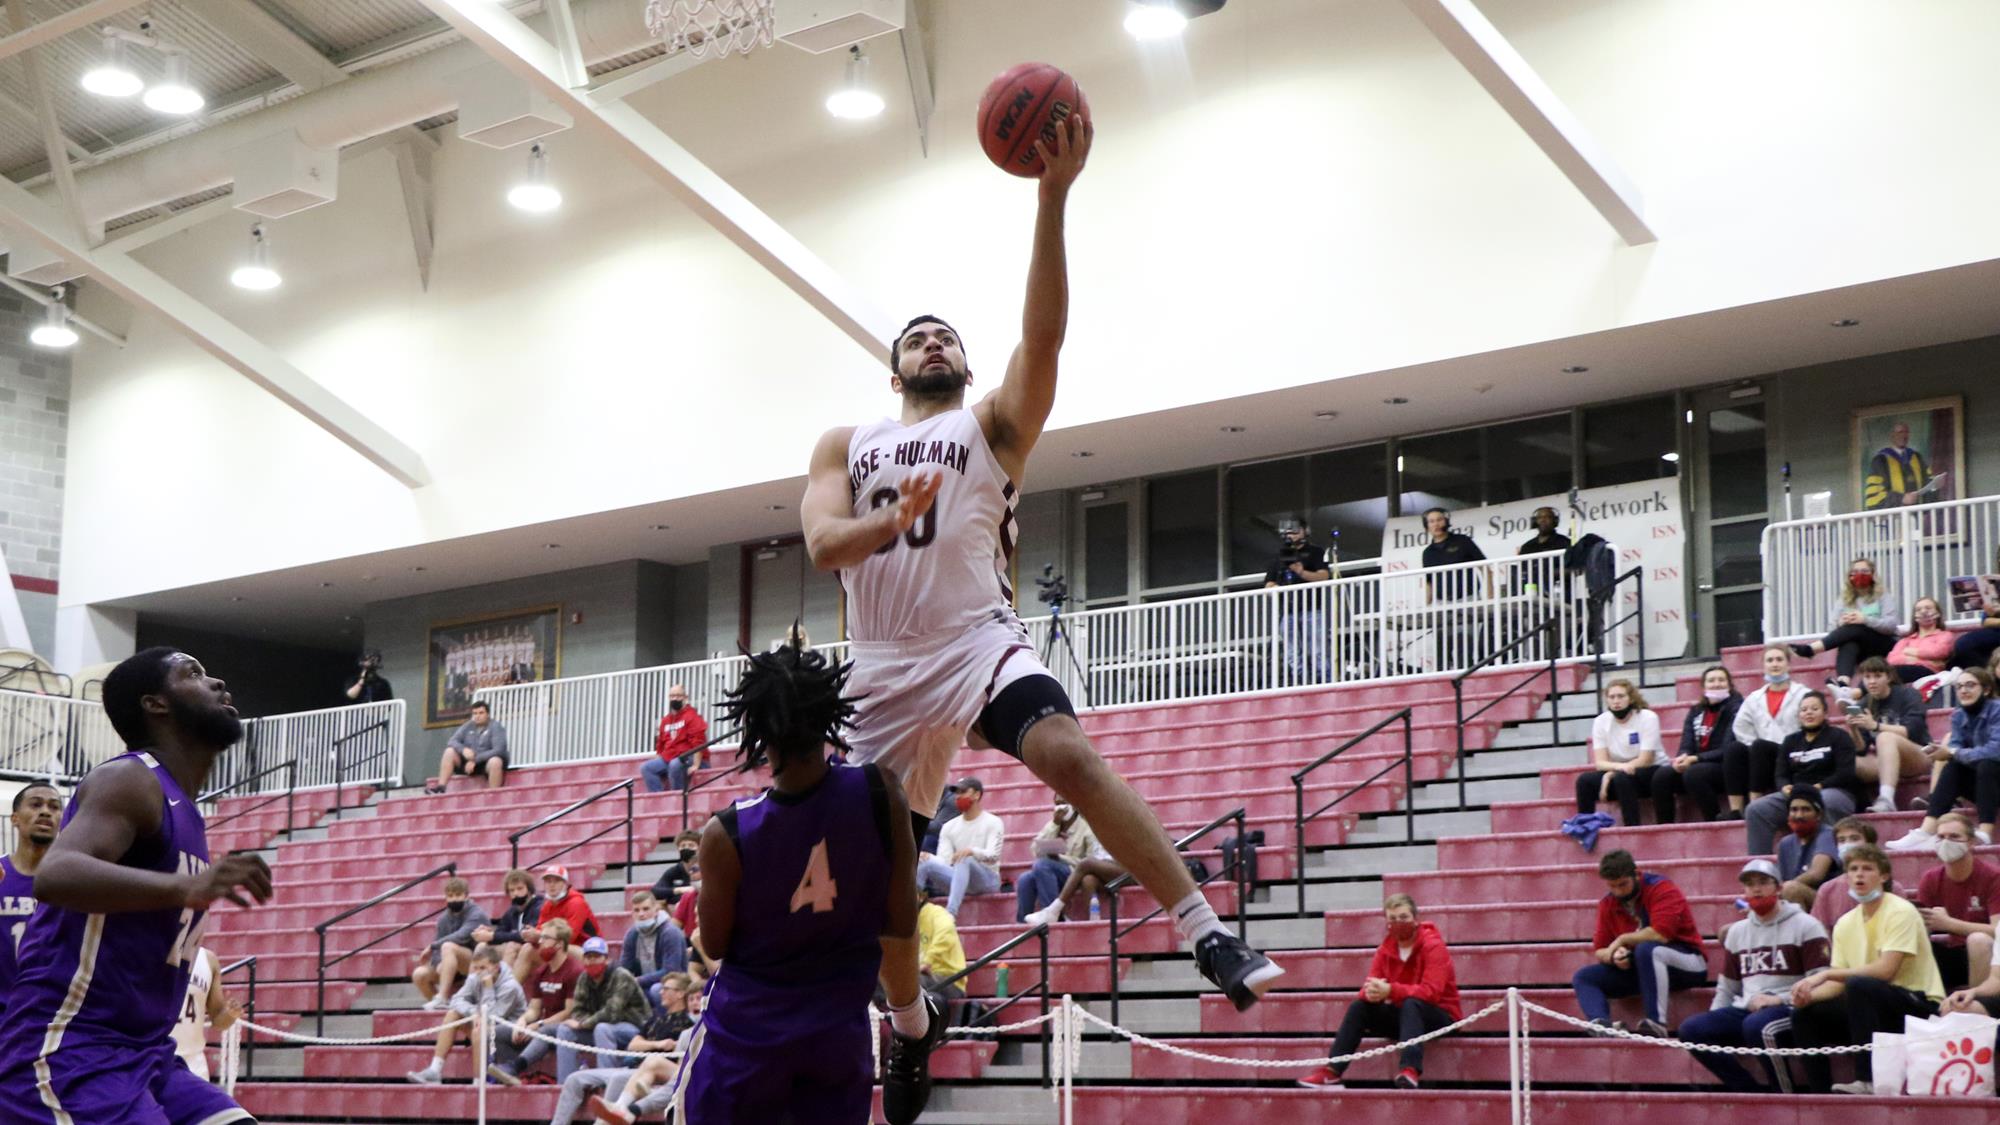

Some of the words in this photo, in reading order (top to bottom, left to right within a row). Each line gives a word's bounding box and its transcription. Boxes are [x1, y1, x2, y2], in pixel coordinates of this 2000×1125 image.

[996, 87, 1034, 140] NCAA
[1019, 100, 1071, 165] Wilon
[1393, 524, 1474, 549] Indna
[1570, 490, 1668, 521] Network
[1652, 525, 1677, 539] ISN
[1622, 549, 1642, 562] SN
[1387, 561, 1408, 573] ISN
[1654, 567, 1679, 581] ISN
[1655, 609, 1680, 623] ISN
[790, 836, 838, 913] 4
